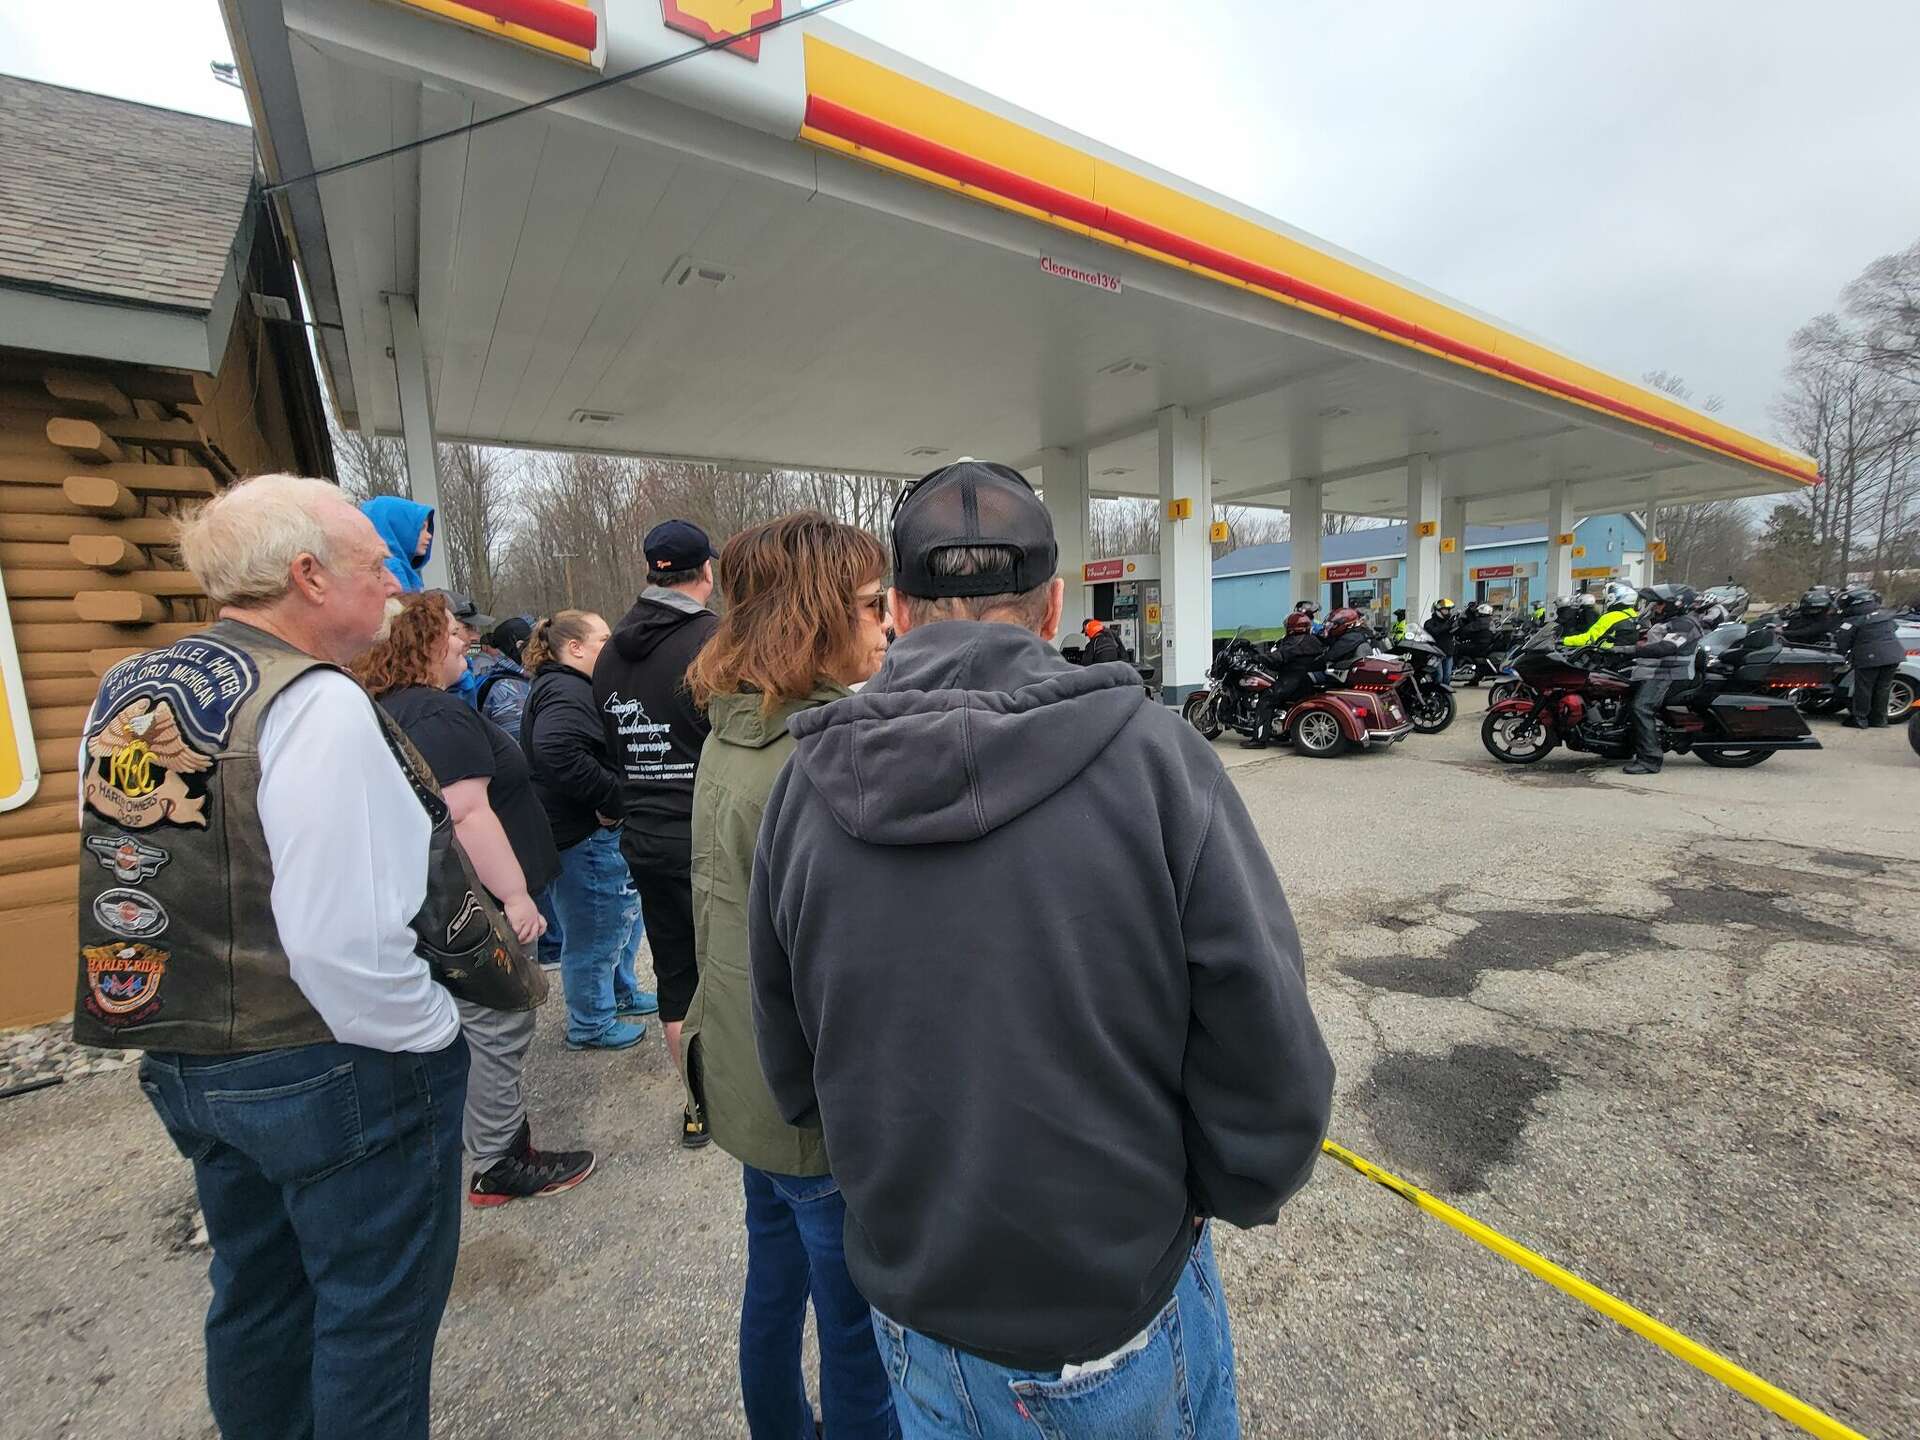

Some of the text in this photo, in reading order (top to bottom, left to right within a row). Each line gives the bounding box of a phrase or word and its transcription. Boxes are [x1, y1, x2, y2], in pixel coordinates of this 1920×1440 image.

[109, 664, 216, 710] GAYLORD MICHIGAN
[88, 960, 130, 974] HARLEY
